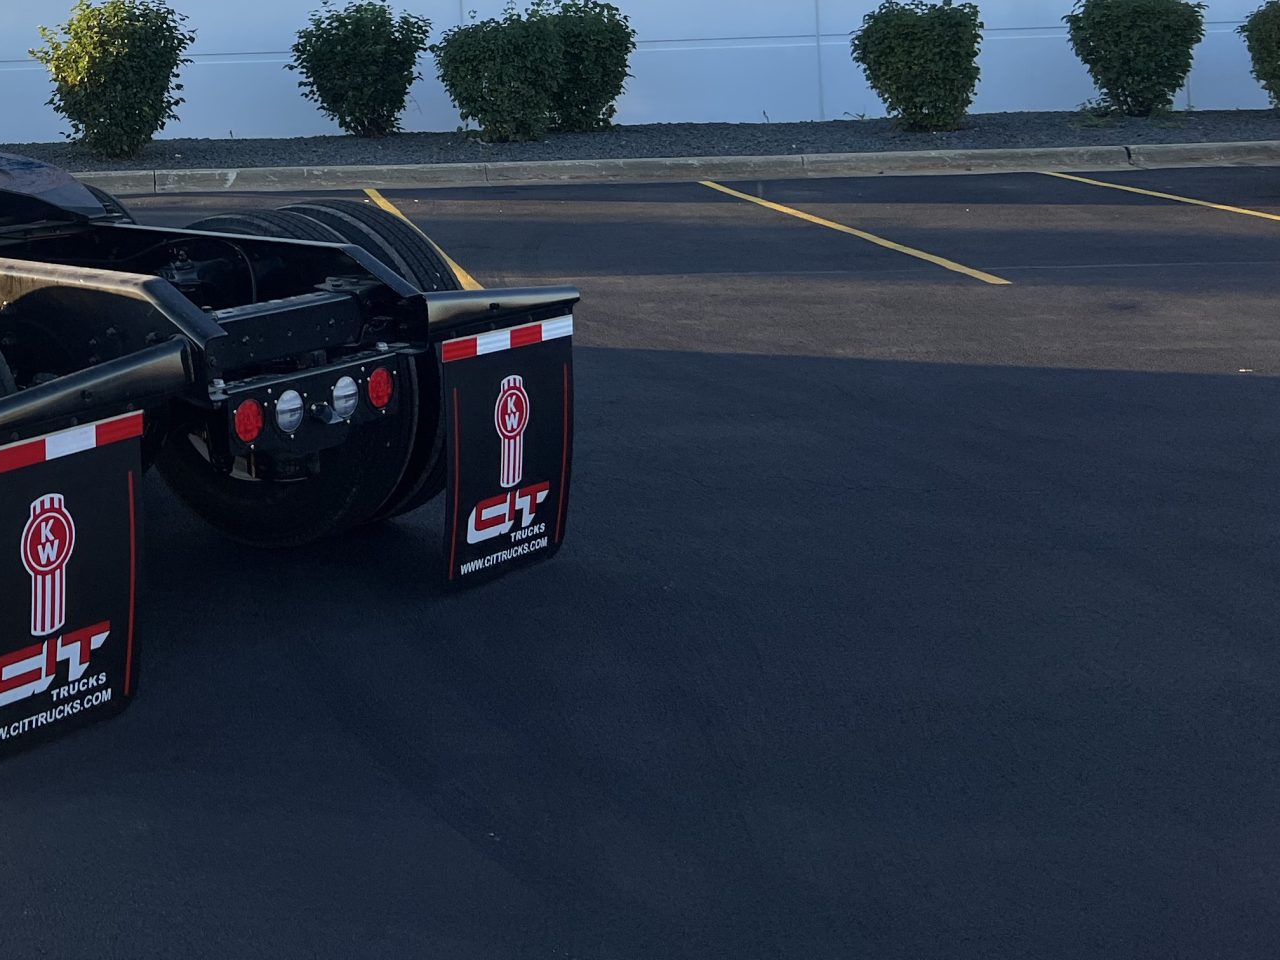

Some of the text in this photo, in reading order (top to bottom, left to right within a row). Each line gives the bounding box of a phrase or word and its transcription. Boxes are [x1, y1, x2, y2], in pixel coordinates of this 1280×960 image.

[466, 480, 550, 544] CIT
[510, 522, 546, 542] TRUCKS
[460, 536, 548, 576] WWW.CITTRUCKS.COM
[51, 672, 107, 702] TRUCKS
